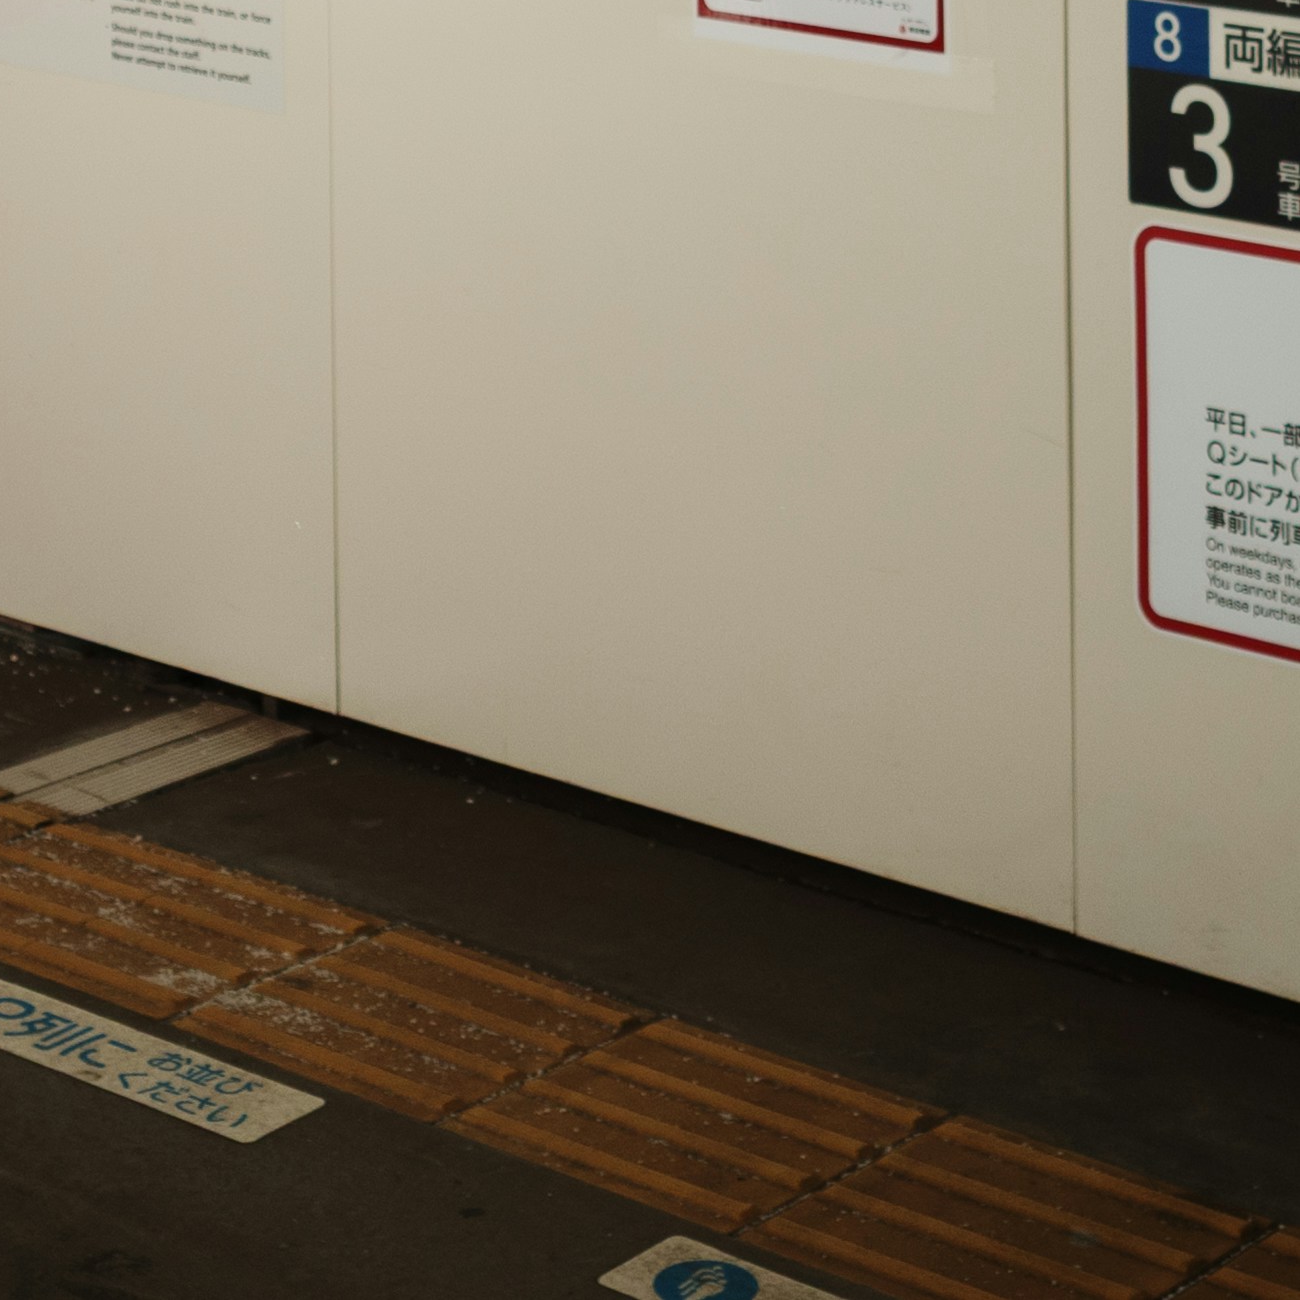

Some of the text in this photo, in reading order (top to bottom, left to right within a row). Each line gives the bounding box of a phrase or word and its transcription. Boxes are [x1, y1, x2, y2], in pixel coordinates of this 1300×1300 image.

[1153, 11, 1300, 79] 8 両編
[1168, 83, 1234, 209] 3
[1206, 406, 1300, 448] 平日、一部
[1206, 537, 1296, 571] On weekdays,
[1206, 557, 1262, 581] operates
[1266, 572, 1281, 585] as
[1206, 591, 1250, 614] Please
[1207, 573, 1230, 591] You
[1234, 581, 1277, 602] cannot
[145, 1051, 265, 1096] お並び
[118, 1070, 249, 1129] ください
